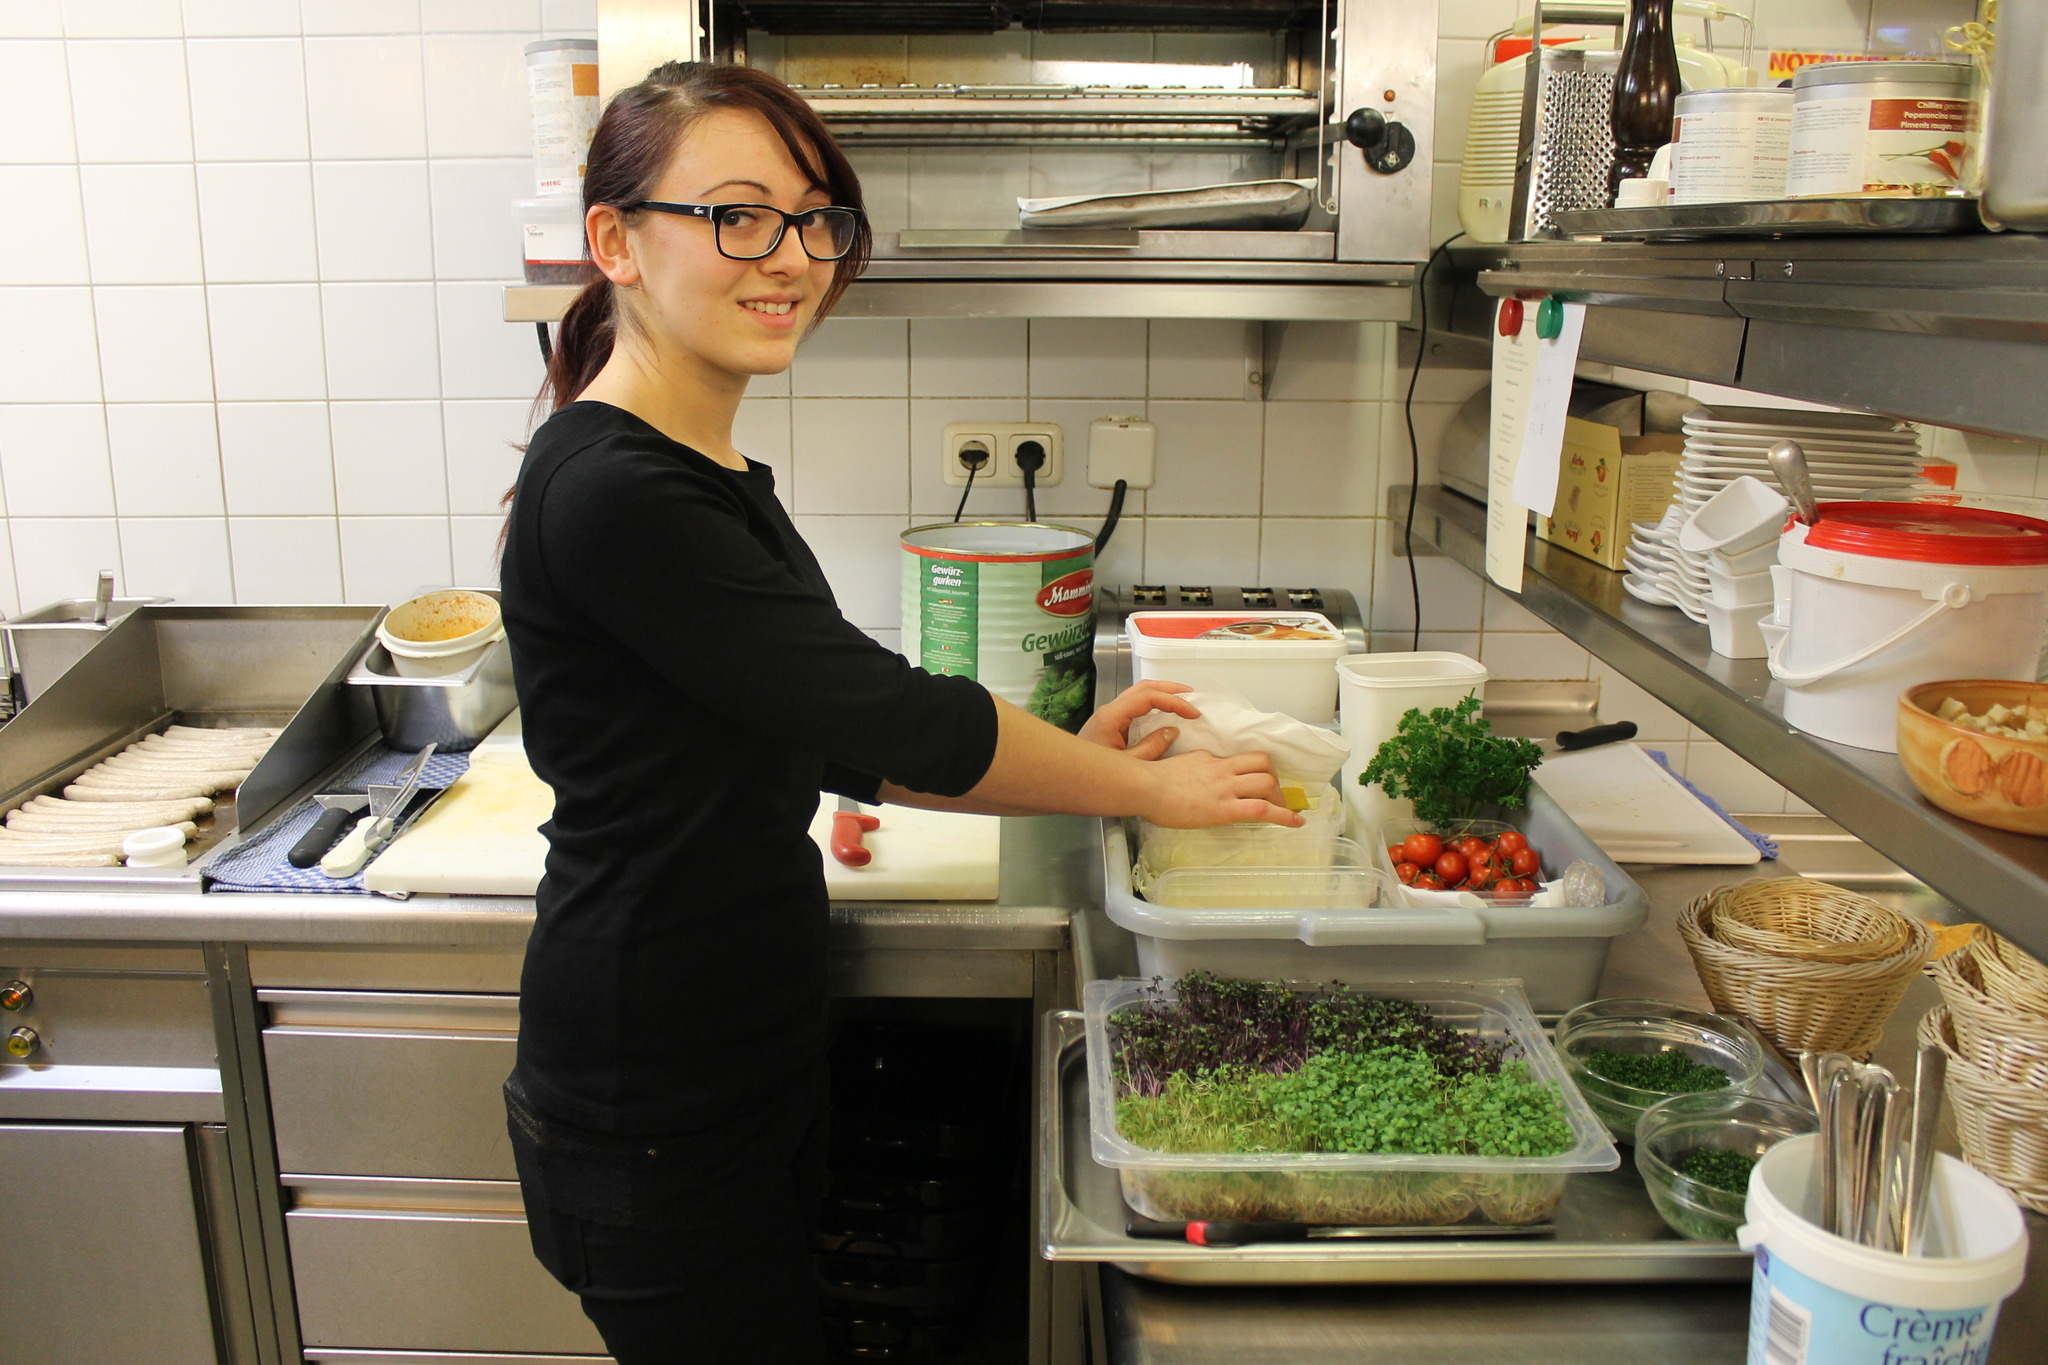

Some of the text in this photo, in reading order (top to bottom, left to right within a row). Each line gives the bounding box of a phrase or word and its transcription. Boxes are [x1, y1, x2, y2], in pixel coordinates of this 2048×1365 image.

[1904, 112, 1949, 120] Peperoncino
[1901, 121, 1930, 129] Piments
[931, 564, 964, 577] Gewürz-
[932, 575, 962, 587] gurken
[1860, 1302, 1983, 1343] Crème
